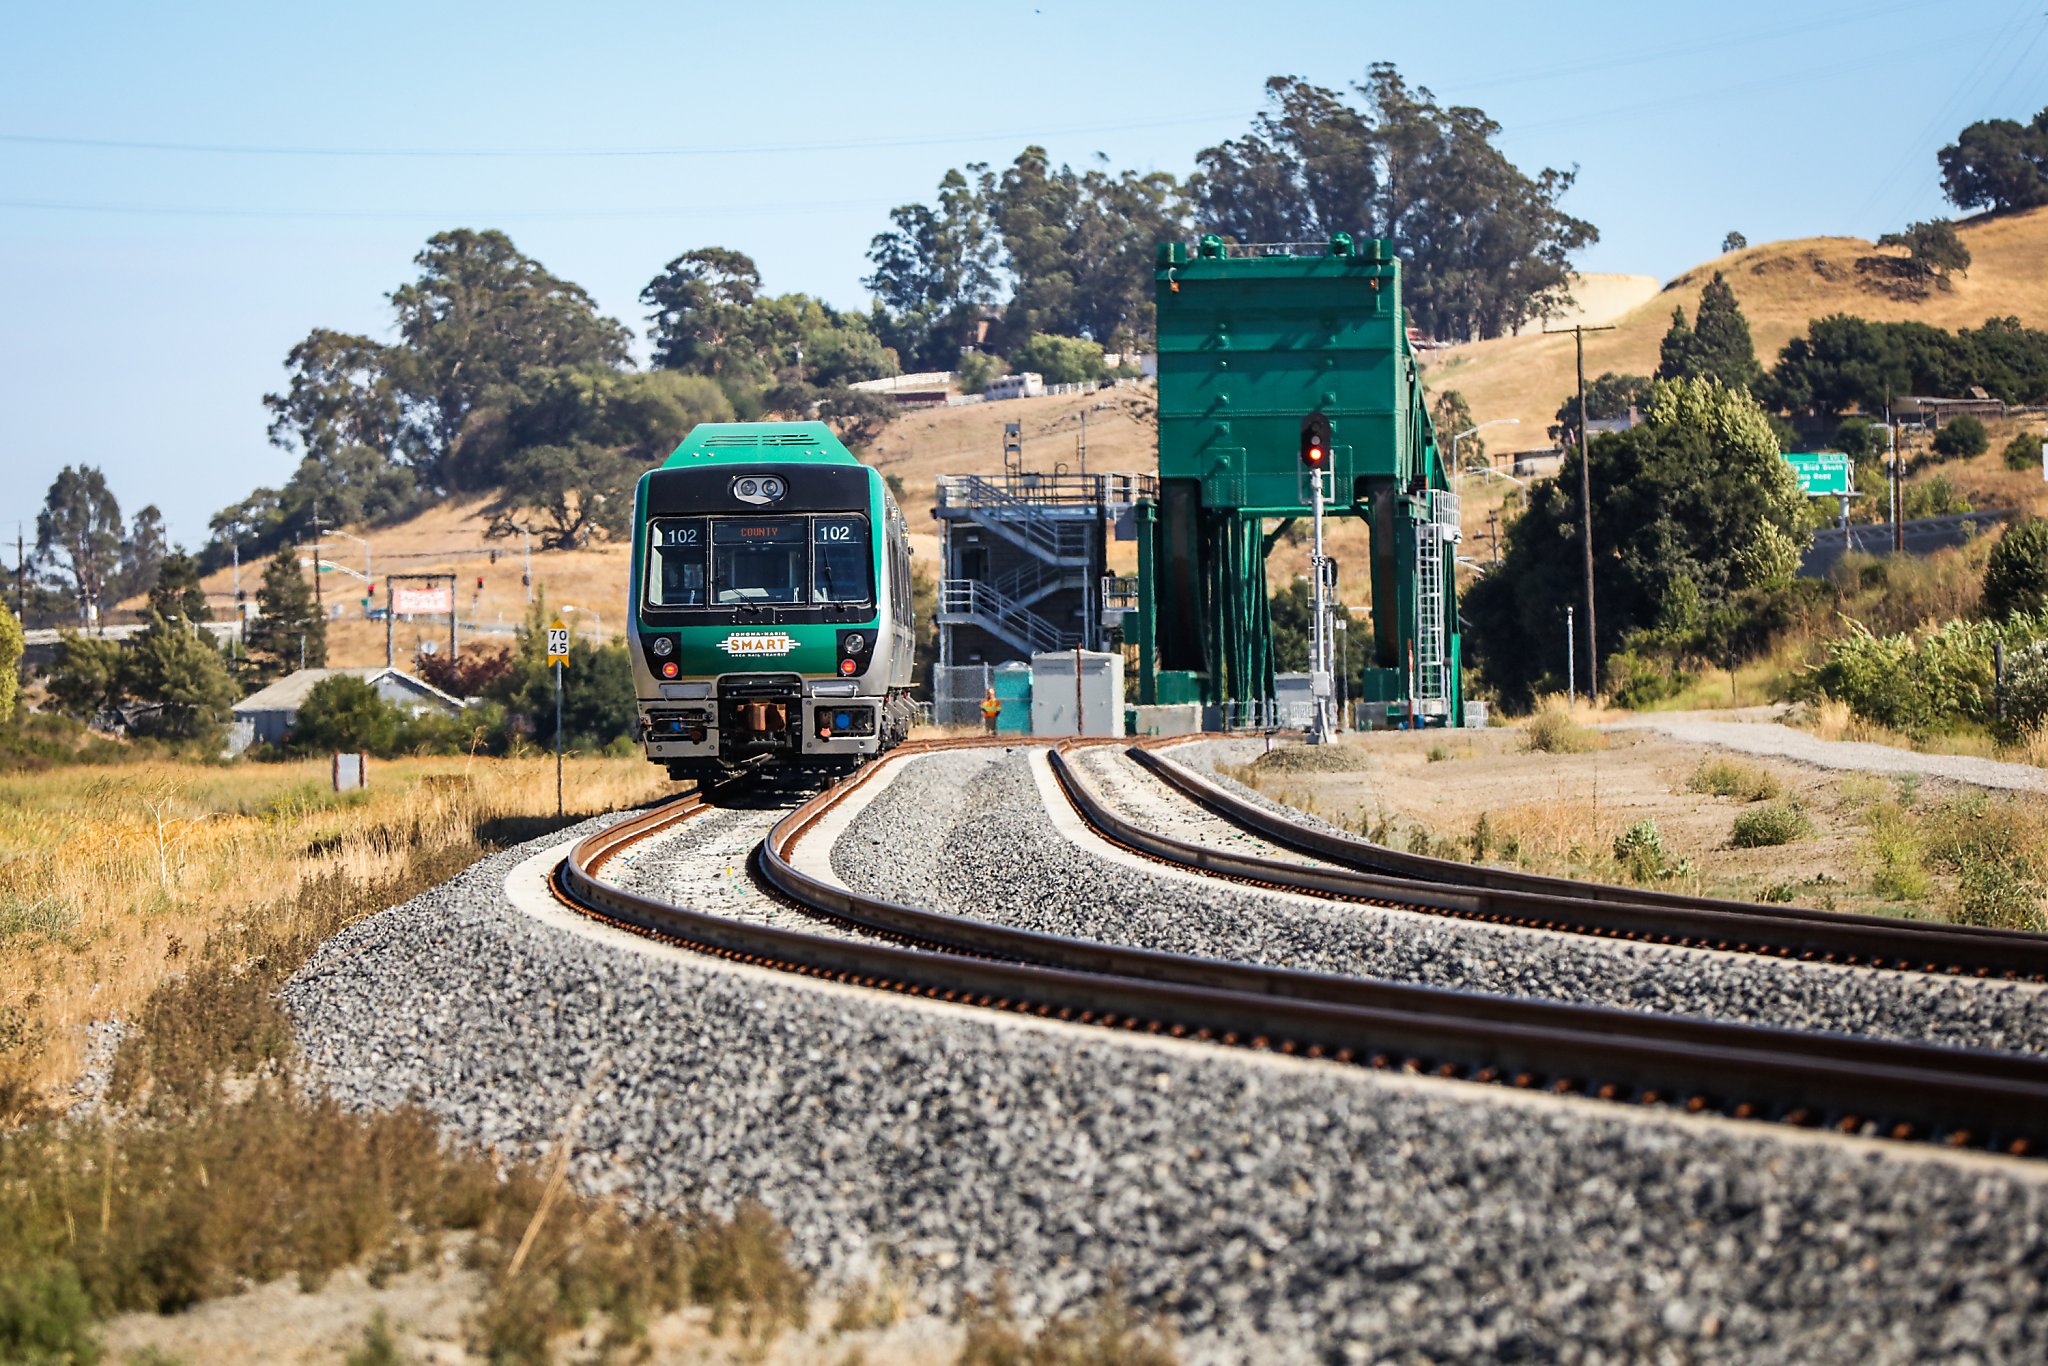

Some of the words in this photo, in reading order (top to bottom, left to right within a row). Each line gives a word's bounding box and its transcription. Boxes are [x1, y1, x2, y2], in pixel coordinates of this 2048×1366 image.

[668, 529, 697, 543] 102
[741, 528, 778, 537] COUNTY
[820, 526, 850, 541] 102
[550, 630, 567, 641] 70
[549, 643, 567, 654] 45
[730, 639, 786, 651] SMART
